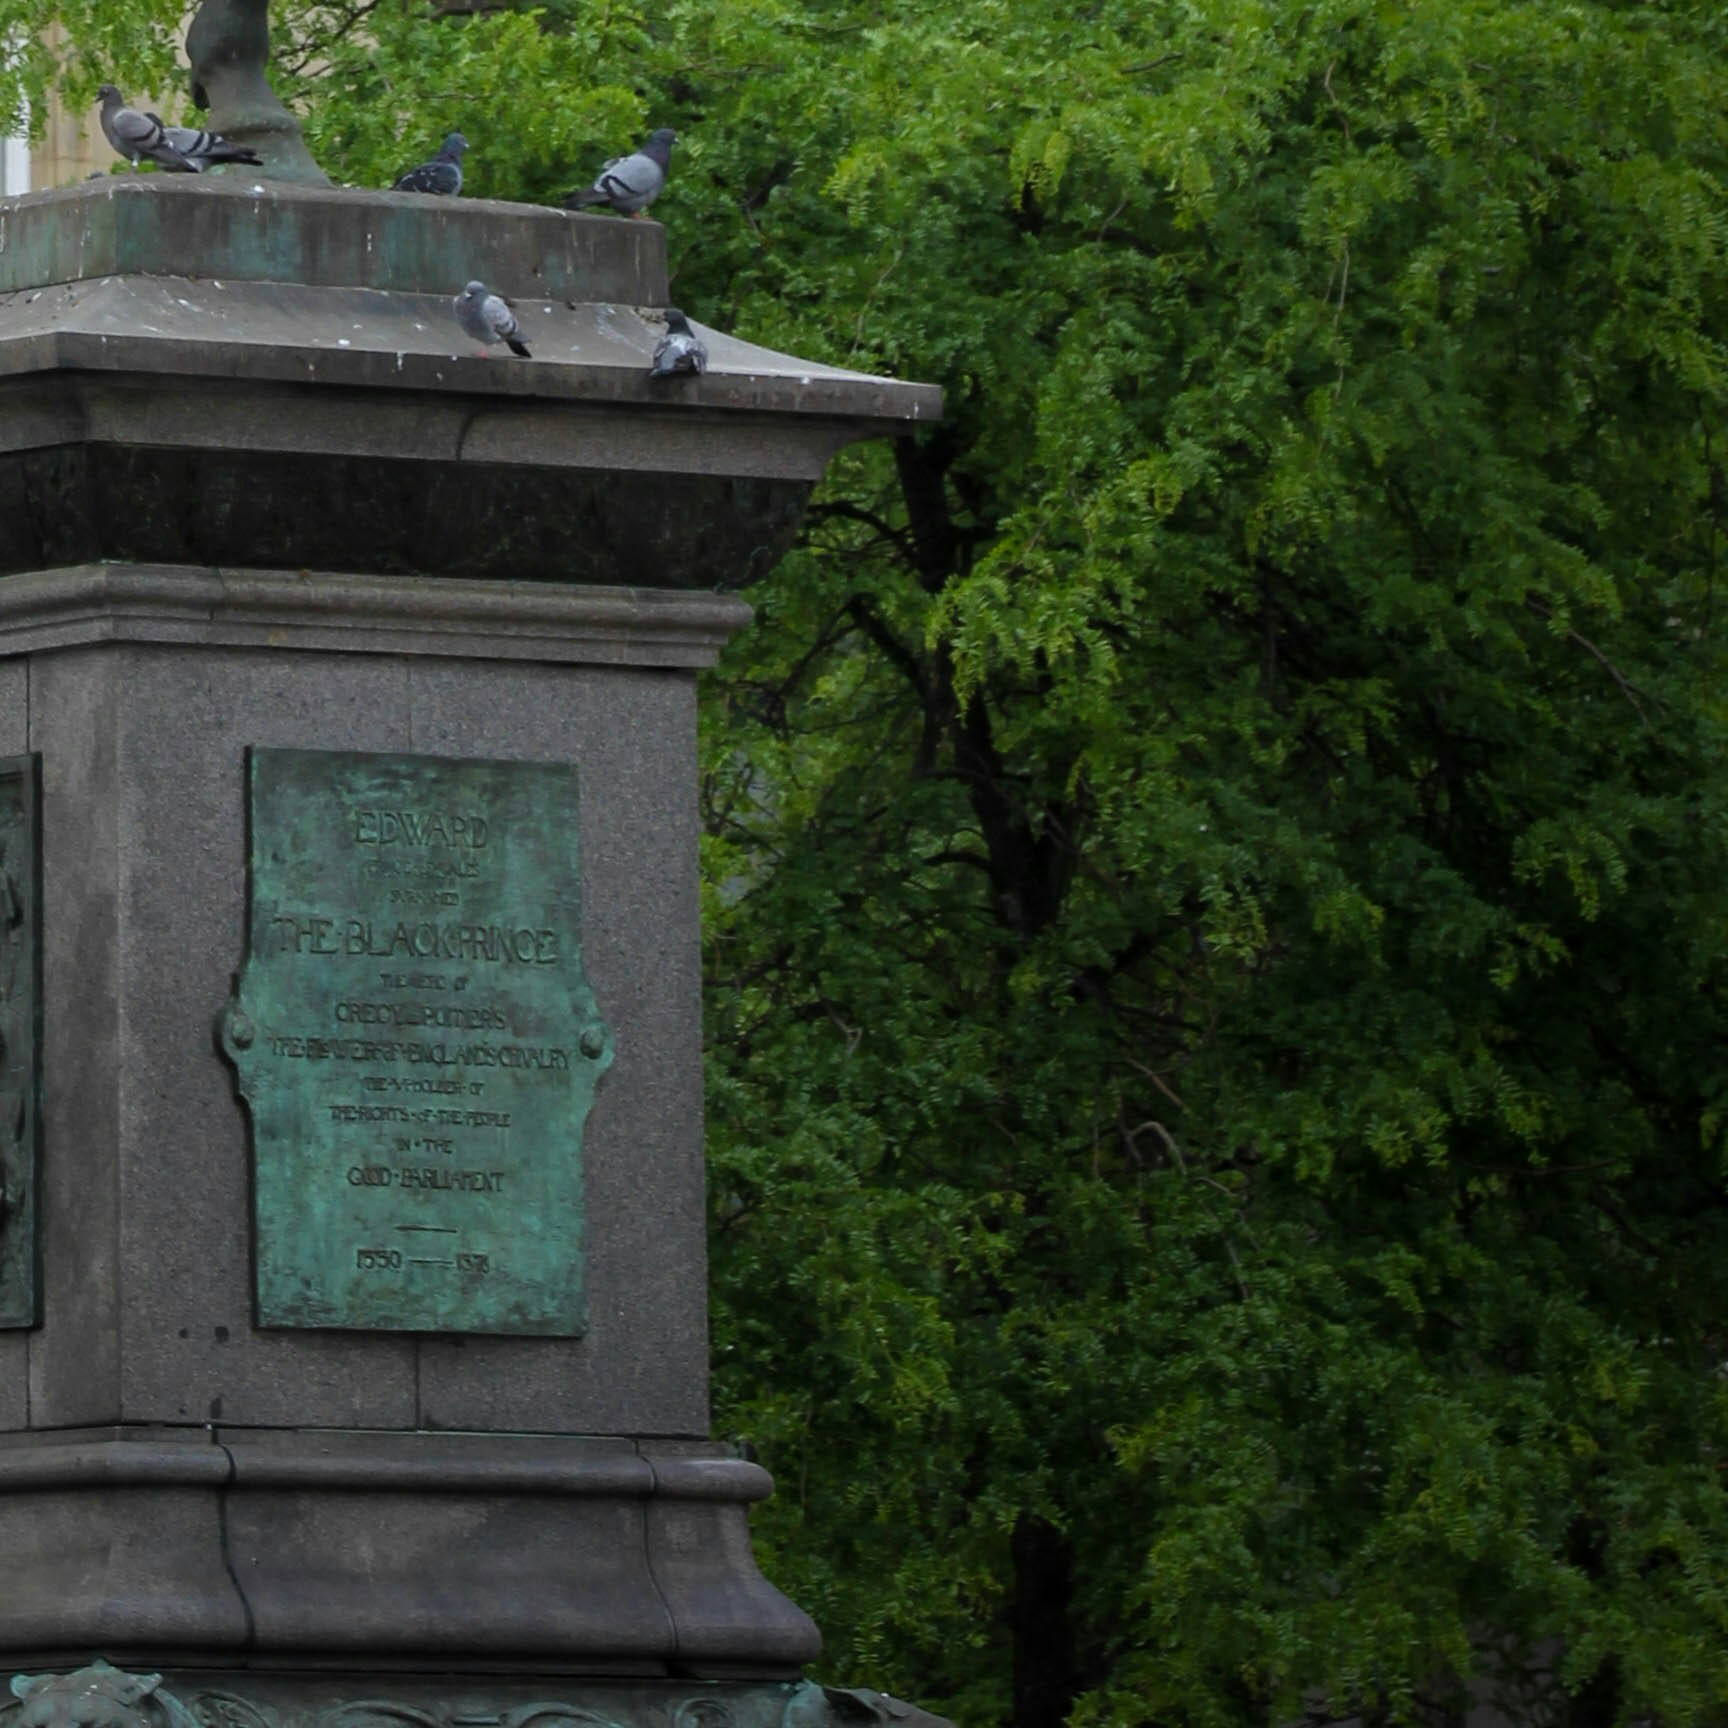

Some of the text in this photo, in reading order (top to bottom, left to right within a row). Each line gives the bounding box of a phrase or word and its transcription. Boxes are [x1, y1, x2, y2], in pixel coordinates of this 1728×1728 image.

[354, 811, 488, 849] EDWARD
[272, 916, 560, 965] THE BLACK PRINCE
[422, 1137, 454, 1155] THE
